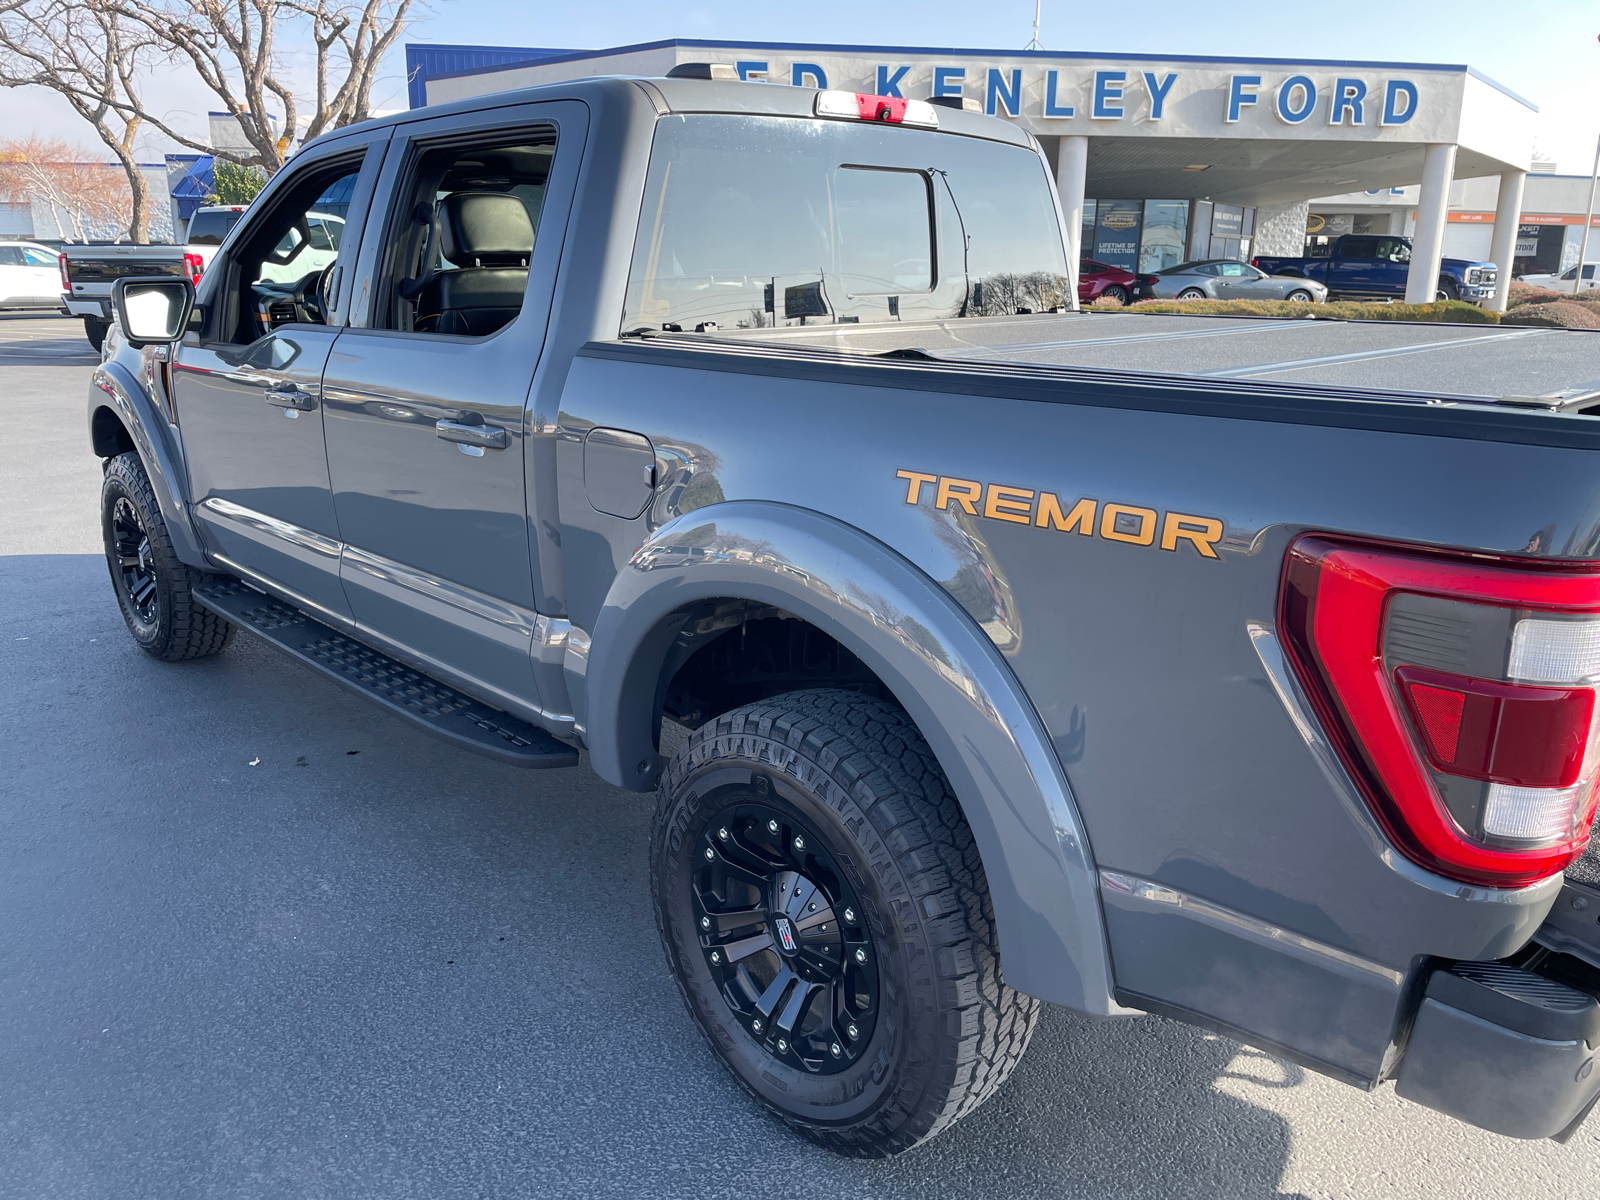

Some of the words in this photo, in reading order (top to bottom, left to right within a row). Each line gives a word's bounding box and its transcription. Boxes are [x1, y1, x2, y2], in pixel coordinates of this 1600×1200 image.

[875, 64, 1182, 121] KENLEY
[1224, 74, 1420, 126] FORD
[896, 468, 1224, 560] TREMOR
